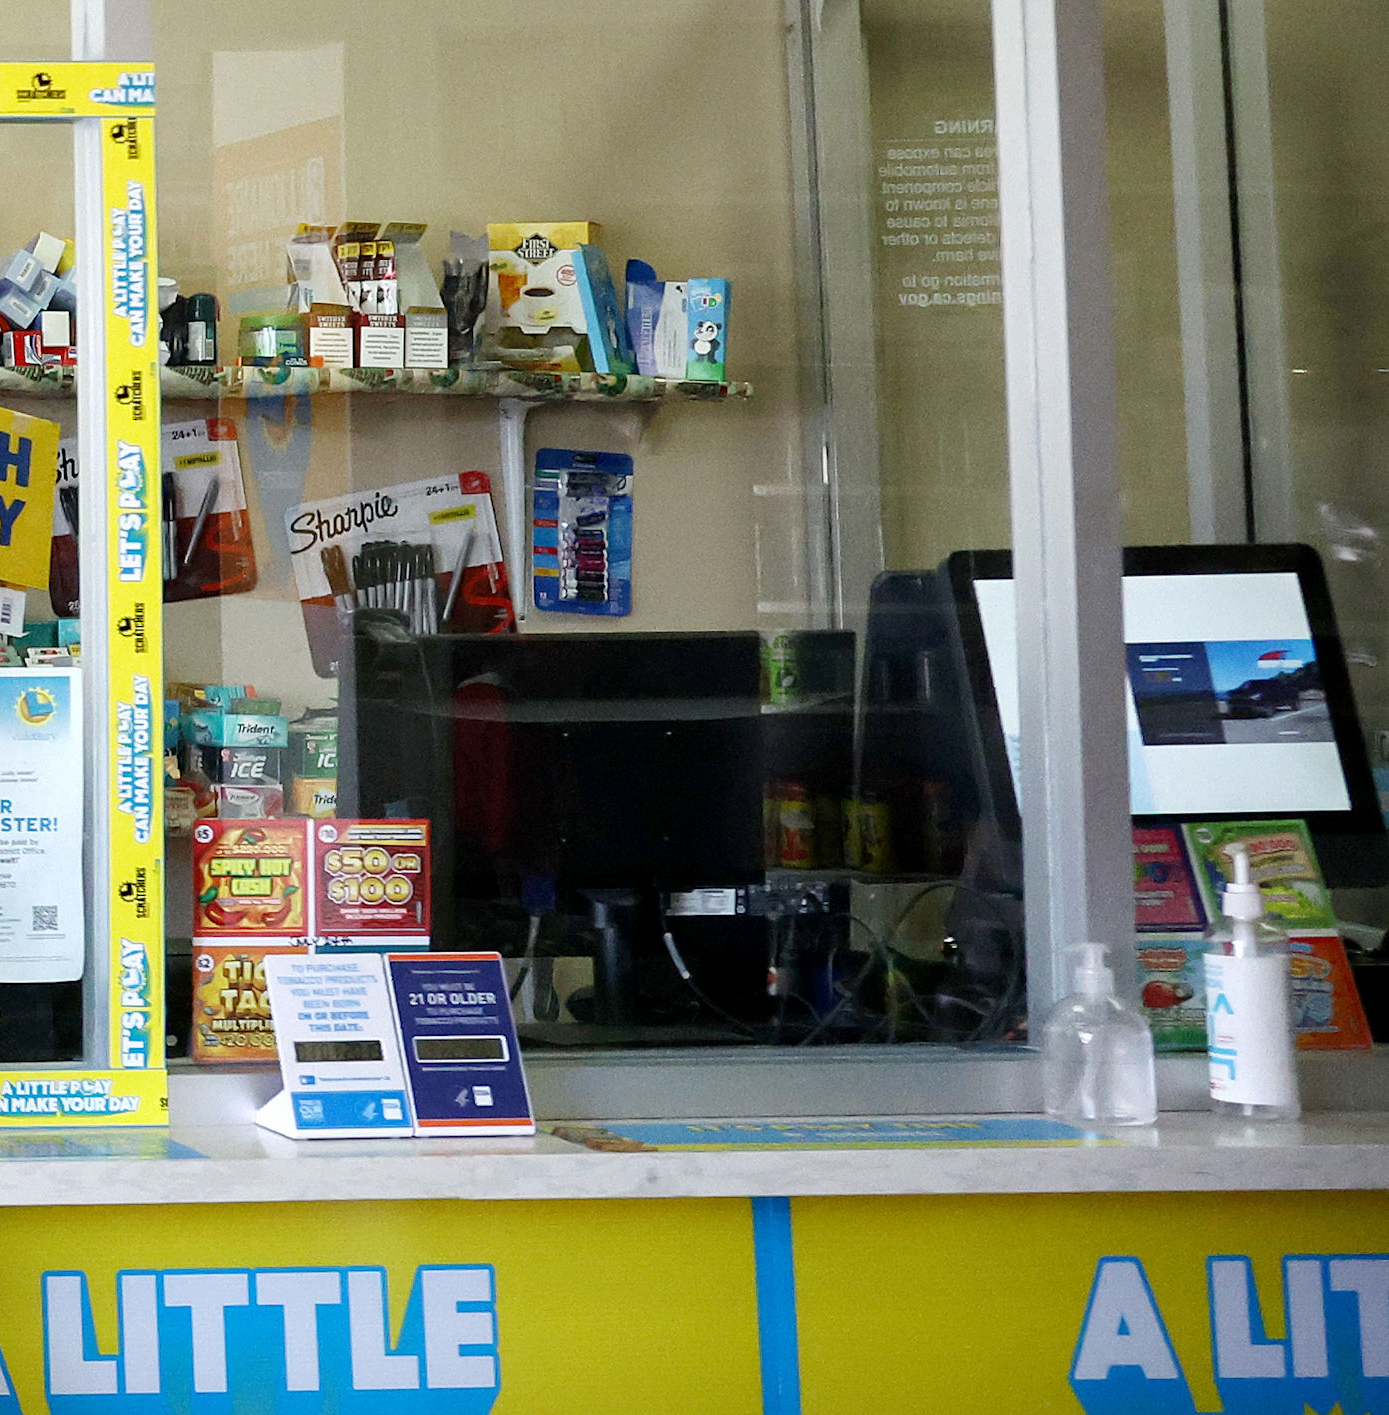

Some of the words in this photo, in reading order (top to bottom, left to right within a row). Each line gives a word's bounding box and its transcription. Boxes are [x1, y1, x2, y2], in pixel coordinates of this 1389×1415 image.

[523, 238, 549, 250] FIRST
[517, 248, 555, 259] STREET
[290, 492, 398, 555] Sharpie
[236, 723, 276, 735] Trident
[229, 761, 266, 779] ICE
[197, 830, 209, 840] $5
[326, 848, 390, 875] $50
[393, 858, 418, 871] OR
[330, 876, 411, 904] $100
[408, 993, 425, 1005] 21
[427, 993, 447, 1005] OR
[450, 992, 497, 1005] OLDER
[44, 1264, 498, 1391] LITTLE
[1074, 1257, 1178, 1380] A
[1210, 1255, 1389, 1384] LIT
